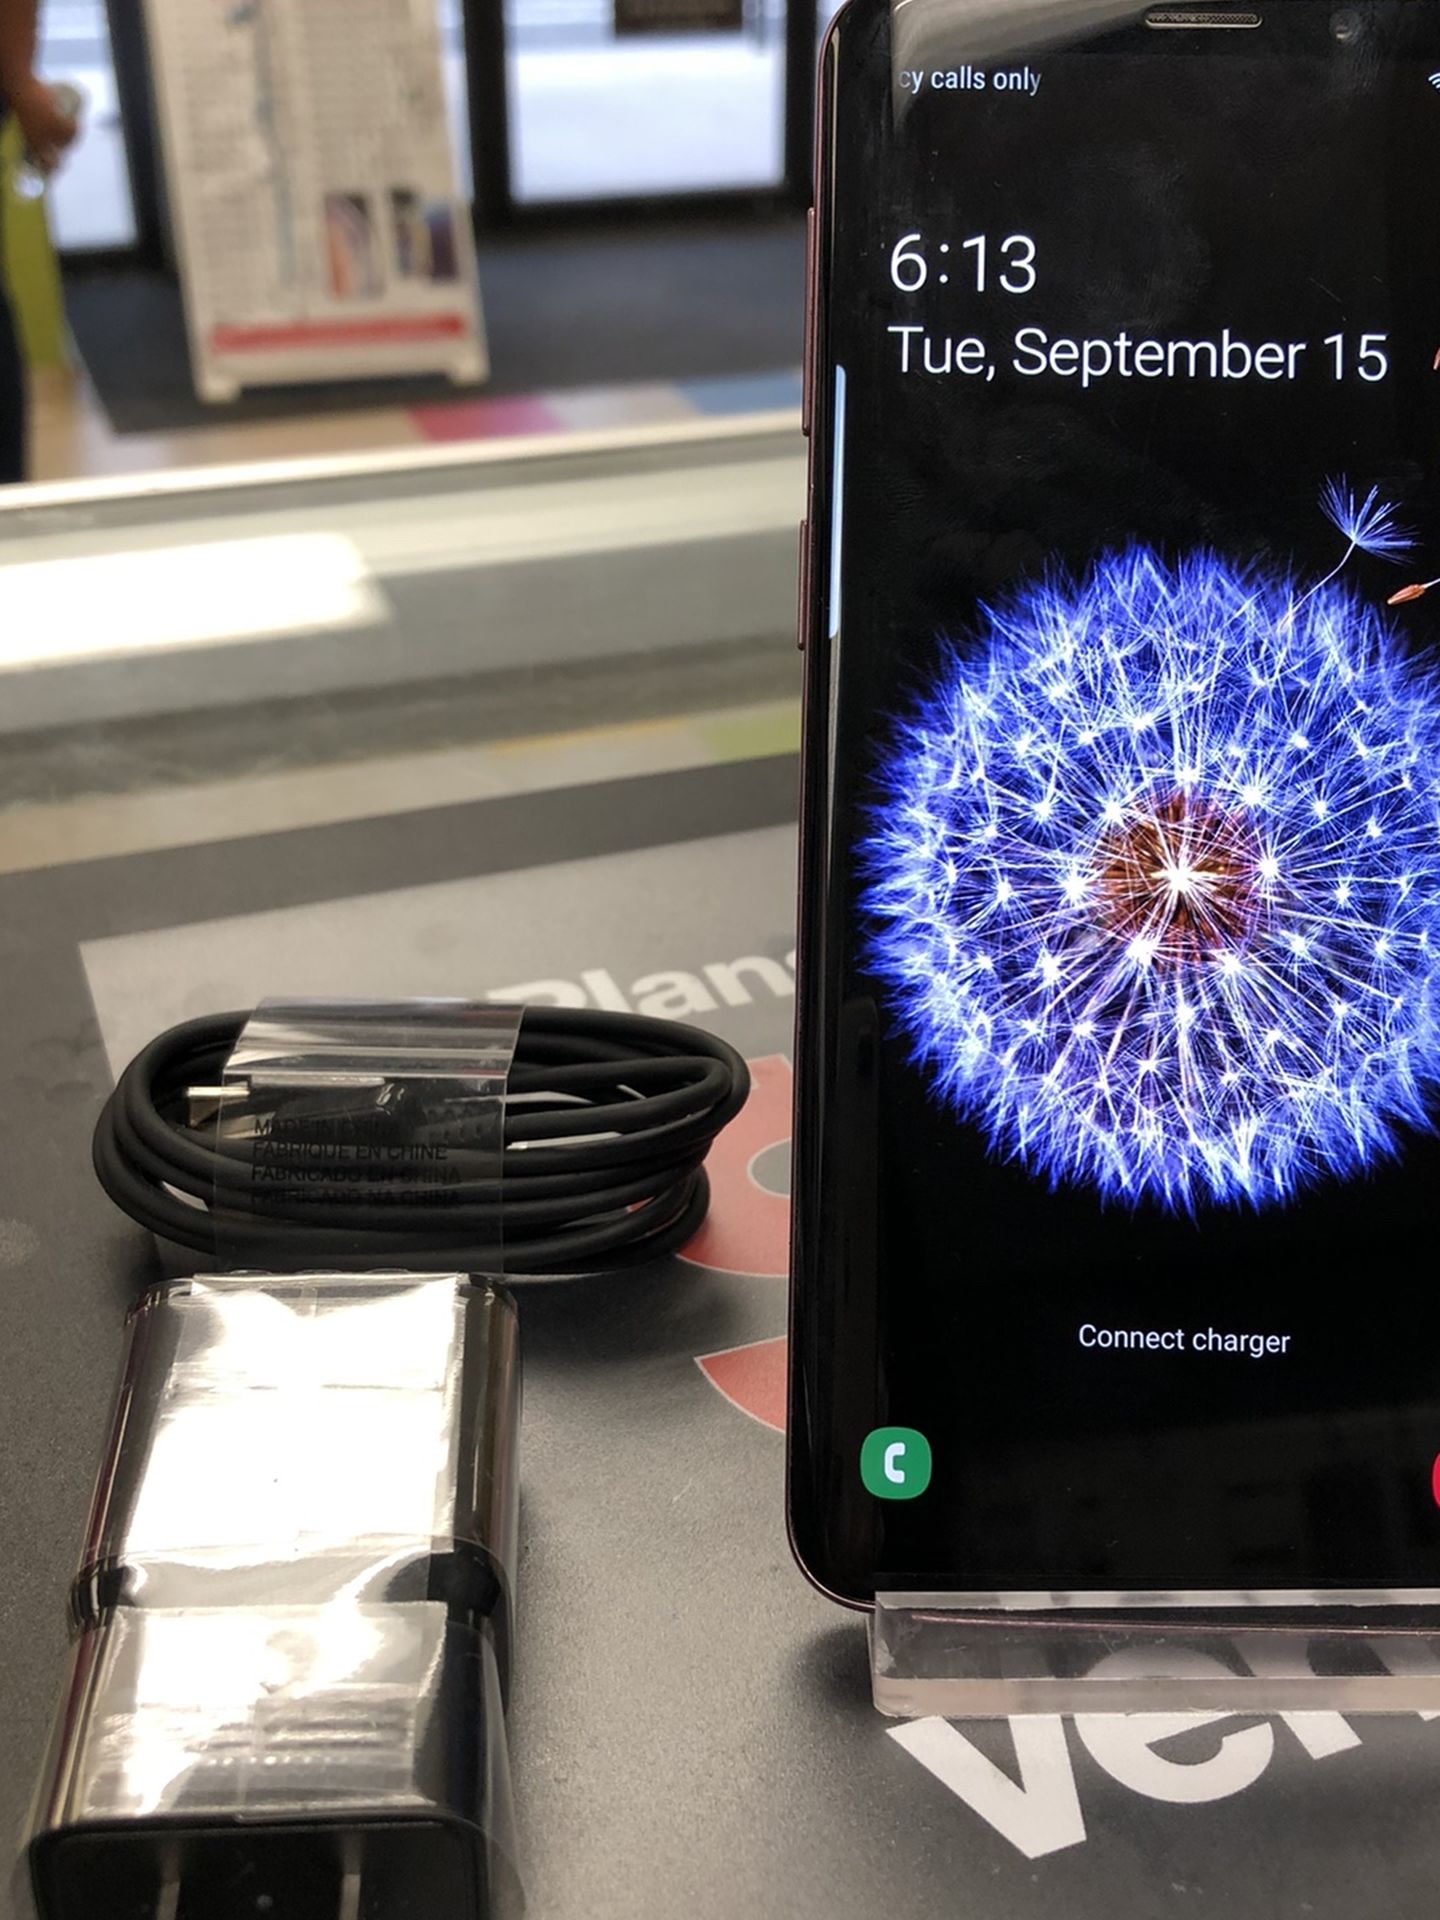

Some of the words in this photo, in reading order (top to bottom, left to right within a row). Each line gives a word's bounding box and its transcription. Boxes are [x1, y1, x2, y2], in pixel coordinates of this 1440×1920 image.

[931, 65, 986, 90] calls
[993, 66, 1041, 97] only
[889, 233, 1037, 293] 6:13
[887, 325, 995, 381] Tue,
[1012, 328, 1306, 387] September
[1323, 333, 1388, 381] 15
[484, 948, 797, 1018] Plan
[356, 1144, 382, 1160] EN
[387, 1144, 448, 1161] CHINE
[252, 1164, 361, 1182] FABRICADO
[1078, 1323, 1184, 1351] Connect
[1192, 1327, 1291, 1358] charger
